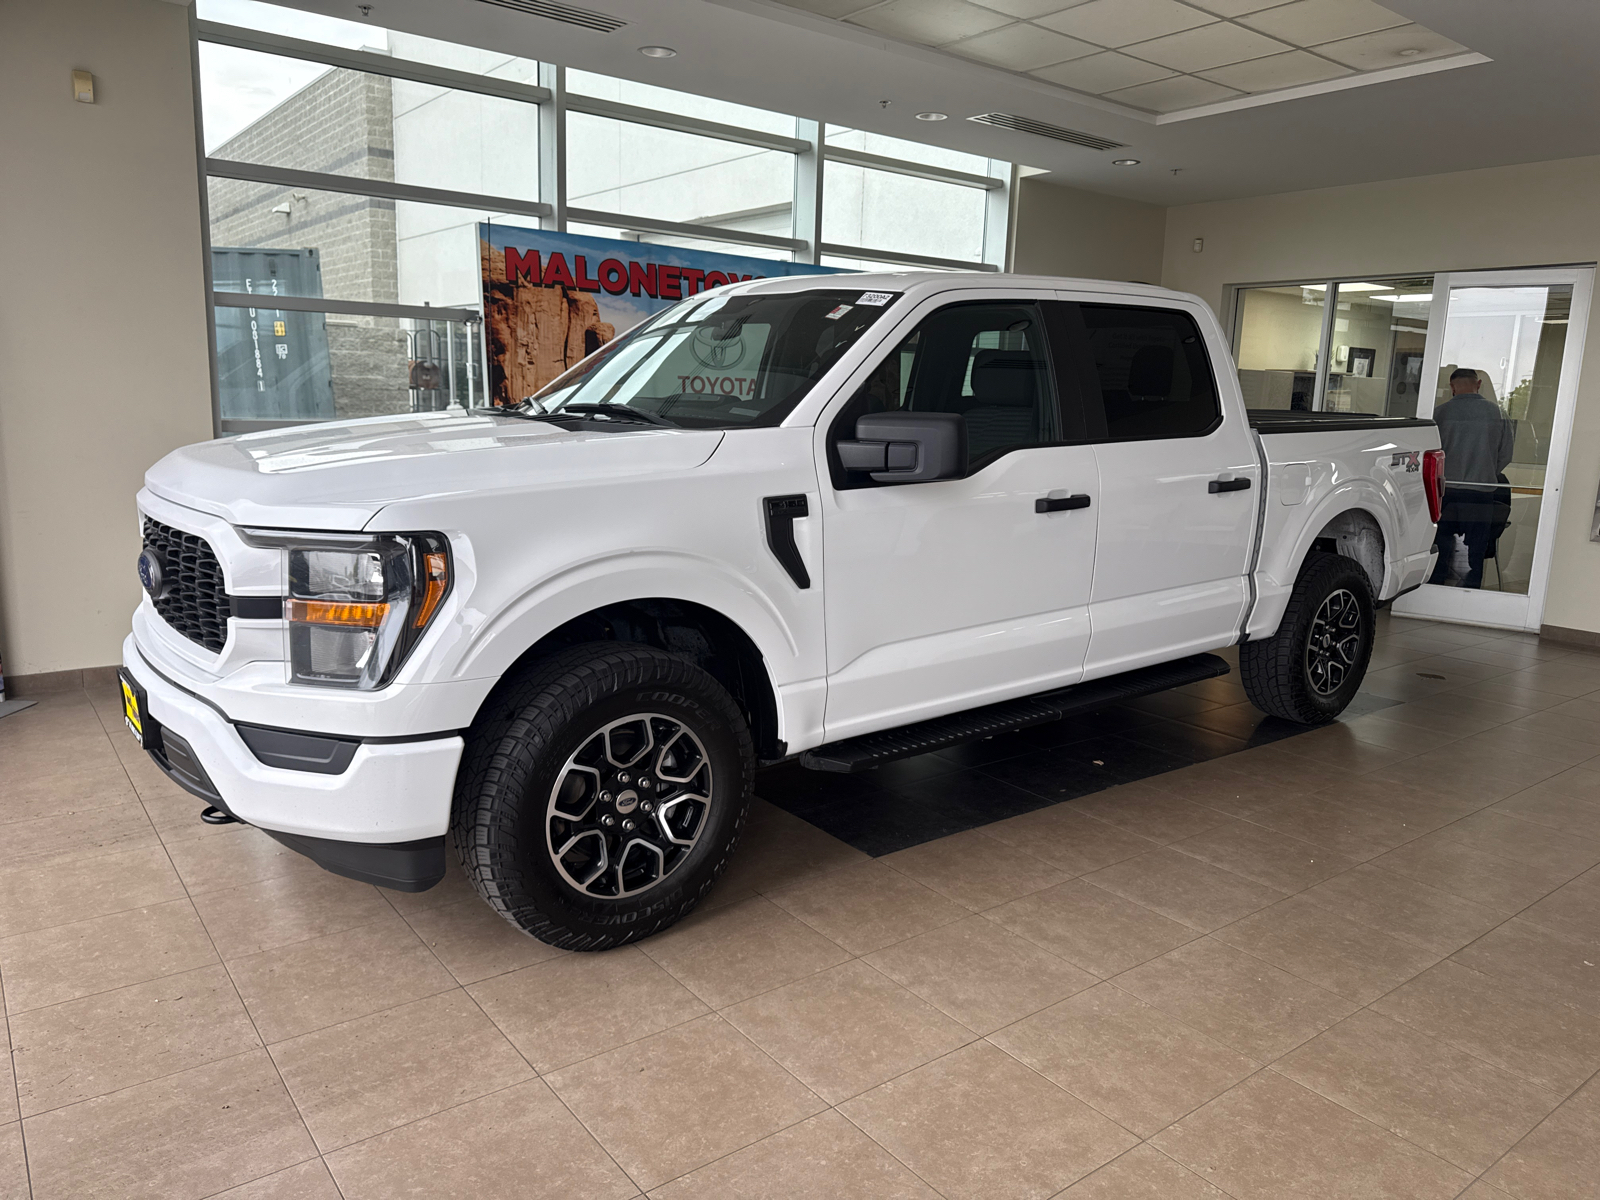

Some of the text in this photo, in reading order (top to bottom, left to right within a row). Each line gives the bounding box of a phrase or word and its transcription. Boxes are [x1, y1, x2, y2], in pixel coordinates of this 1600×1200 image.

[504, 246, 768, 299] MALONETO
[271, 280, 279, 317] 221
[677, 375, 756, 396] TOYOTA
[636, 691, 721, 730] COOPER
